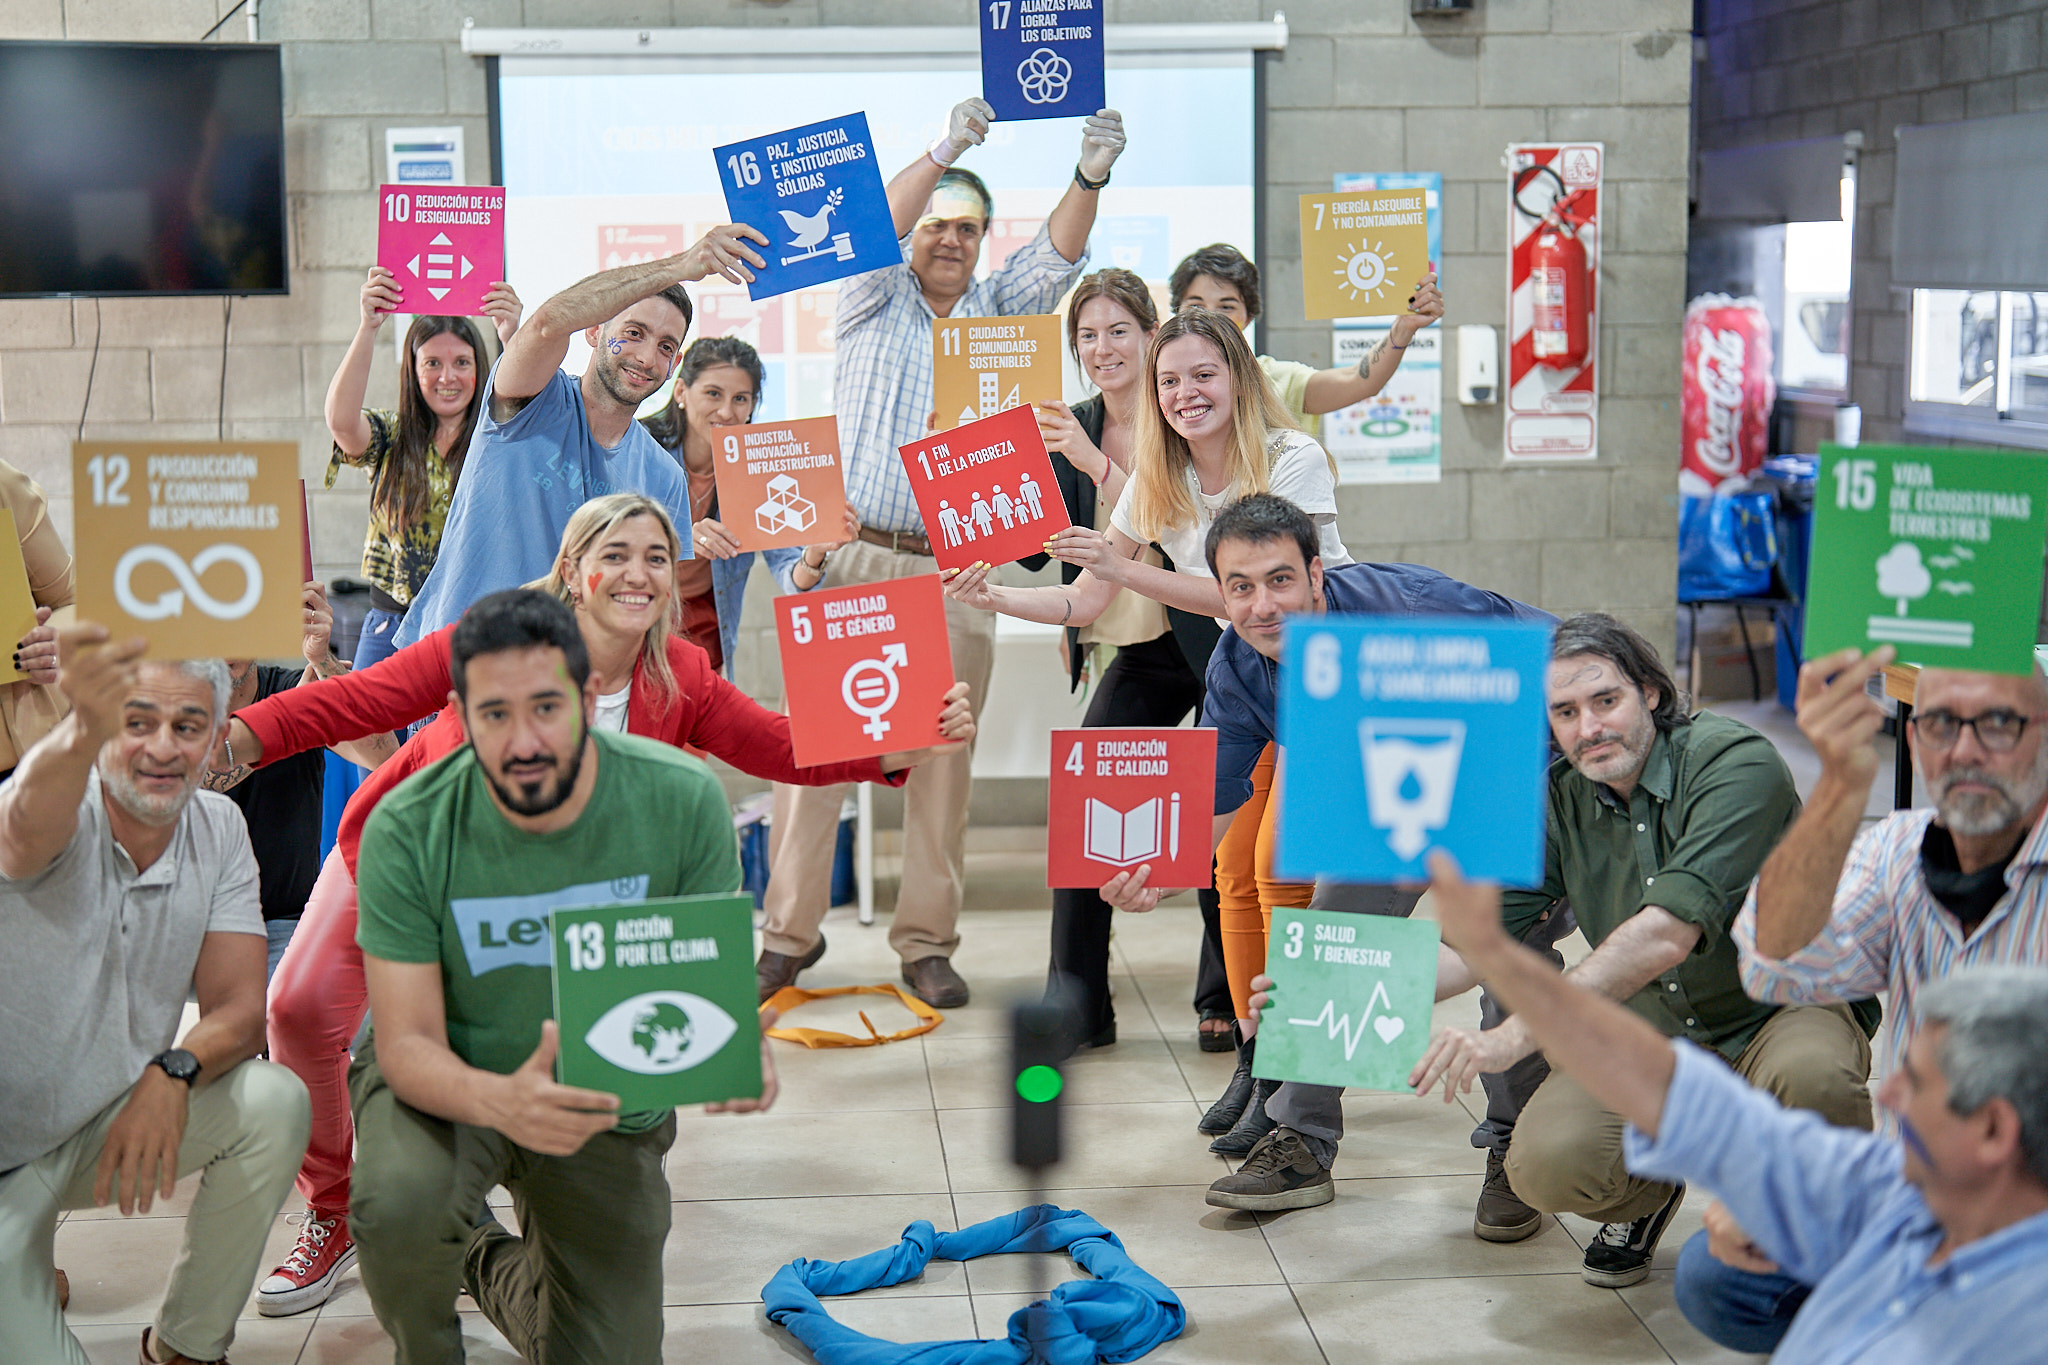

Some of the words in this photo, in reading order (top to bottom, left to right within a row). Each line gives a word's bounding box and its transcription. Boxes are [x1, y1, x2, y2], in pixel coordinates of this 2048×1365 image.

[989, 1, 1011, 30] 17
[1020, 0, 1066, 13] ALIANZAS
[1067, 0, 1093, 10] PARA
[1020, 13, 1058, 28] LOGRAR
[1021, 29, 1039, 43] LOS
[1041, 26, 1092, 41] OBJETIVOS
[766, 142, 794, 161] PAZ,
[796, 128, 848, 154] JUSTICIA
[727, 151, 761, 189] 16
[771, 164, 781, 180] E
[781, 143, 866, 177] INSTITUCIONES
[775, 172, 826, 198] SÓLIDAS
[385, 194, 410, 222] 10
[415, 194, 468, 209] REDUCCIÓN
[470, 196, 483, 209] DE
[485, 196, 503, 210] LAS
[1332, 199, 1370, 214] ENERGÍA
[1372, 197, 1421, 212] ASEQUIBLE
[415, 210, 491, 225] DESIGUALDADES
[1312, 203, 1325, 231] 7
[1332, 217, 1339, 230] Y
[1341, 217, 1354, 229] NO
[1355, 212, 1423, 228] CONTAMINANTE
[608, 336, 627, 355] #6
[941, 327, 960, 355] 11
[968, 326, 1016, 340] CIUDADES
[1018, 325, 1025, 338] Y
[969, 340, 1037, 354] COMUNIDADES
[969, 355, 1031, 369] SOSTENIBLES
[723, 435, 739, 463] 9
[746, 442, 802, 461] INNOVACIÓN
[803, 442, 810, 455] E
[931, 443, 950, 461] FIN
[937, 461, 954, 477] DE
[952, 456, 968, 472] LA
[967, 440, 1016, 467] POBREZA
[747, 454, 835, 475] INFRAESTRUCTURA
[917, 450, 934, 481] 1
[87, 453, 131, 507] 12
[1832, 458, 1877, 511] 15
[823, 594, 887, 620] IGUALDAD
[790, 605, 813, 644] 5
[826, 621, 845, 640] DE
[846, 613, 896, 638] GÉNERO
[1303, 631, 1342, 700] 6
[1064, 741, 1085, 776] 4
[1097, 738, 1167, 757] EDUCACIÓN
[1096, 760, 1113, 776] DE
[1115, 760, 1169, 776] CALIDAD
[615, 914, 673, 943] ACCIÓN
[1284, 921, 1305, 959] 3
[1314, 924, 1356, 944] SALUD
[564, 921, 606, 972] 13
[615, 944, 649, 968] POR
[652, 942, 669, 965] EL
[670, 937, 719, 963] CLIMA
[1313, 944, 1323, 961] Y
[1324, 945, 1392, 968] BIENESTAR
